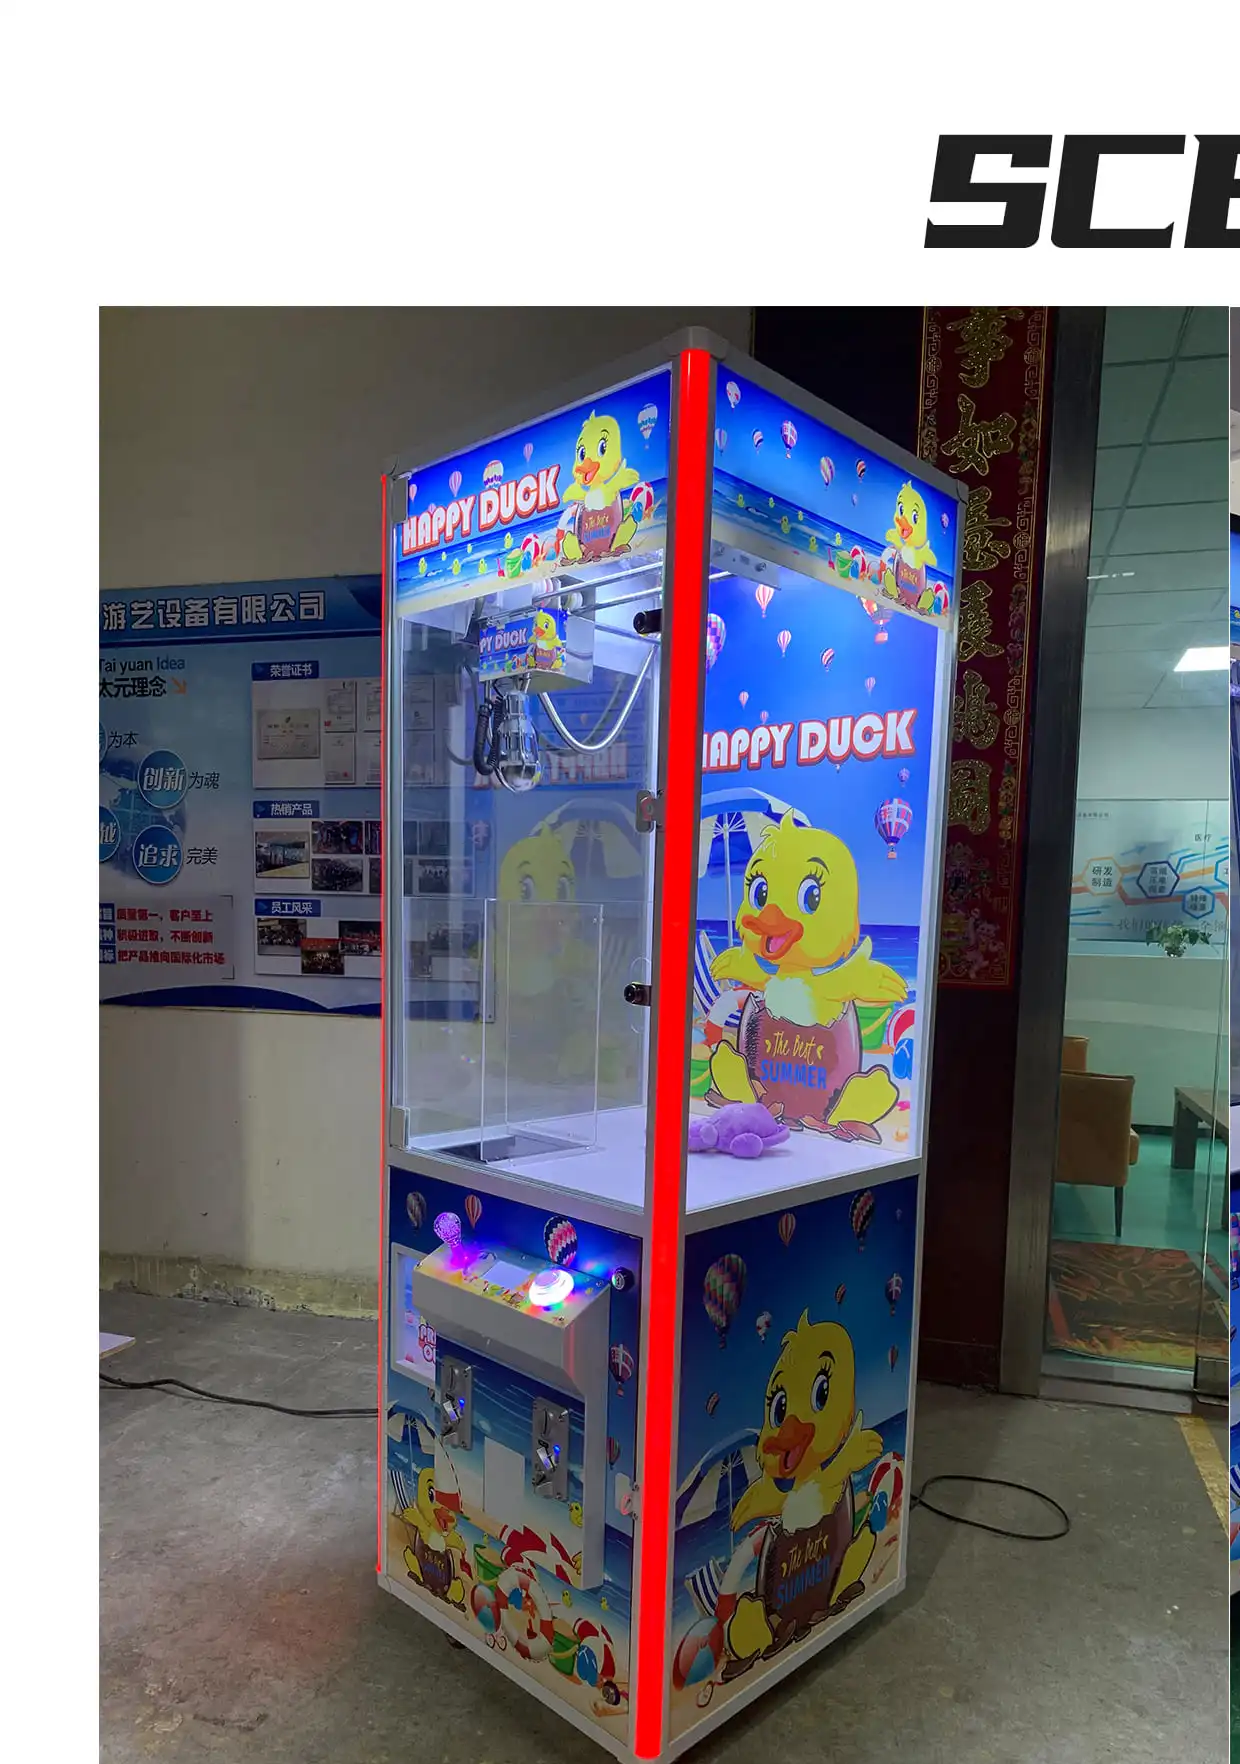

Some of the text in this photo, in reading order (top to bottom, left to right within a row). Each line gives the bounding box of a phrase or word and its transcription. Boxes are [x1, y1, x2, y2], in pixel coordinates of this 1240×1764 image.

[402, 463, 561, 556] HAPPY DUCK
[102, 592, 326, 631] 游艺设备有限公司
[120, 659, 153, 676] yuan
[156, 657, 185, 670] Idea
[99, 676, 167, 698] 太元理念
[108, 731, 139, 748] 为本
[797, 708, 917, 768] DUCK
[143, 768, 185, 791] 创新
[189, 772, 219, 790] 为魂
[139, 844, 178, 867] 追求
[186, 847, 218, 865] 完美
[271, 901, 312, 914] 员工风采
[772, 1031, 791, 1058] The
[761, 1060, 827, 1089] SUMMER
